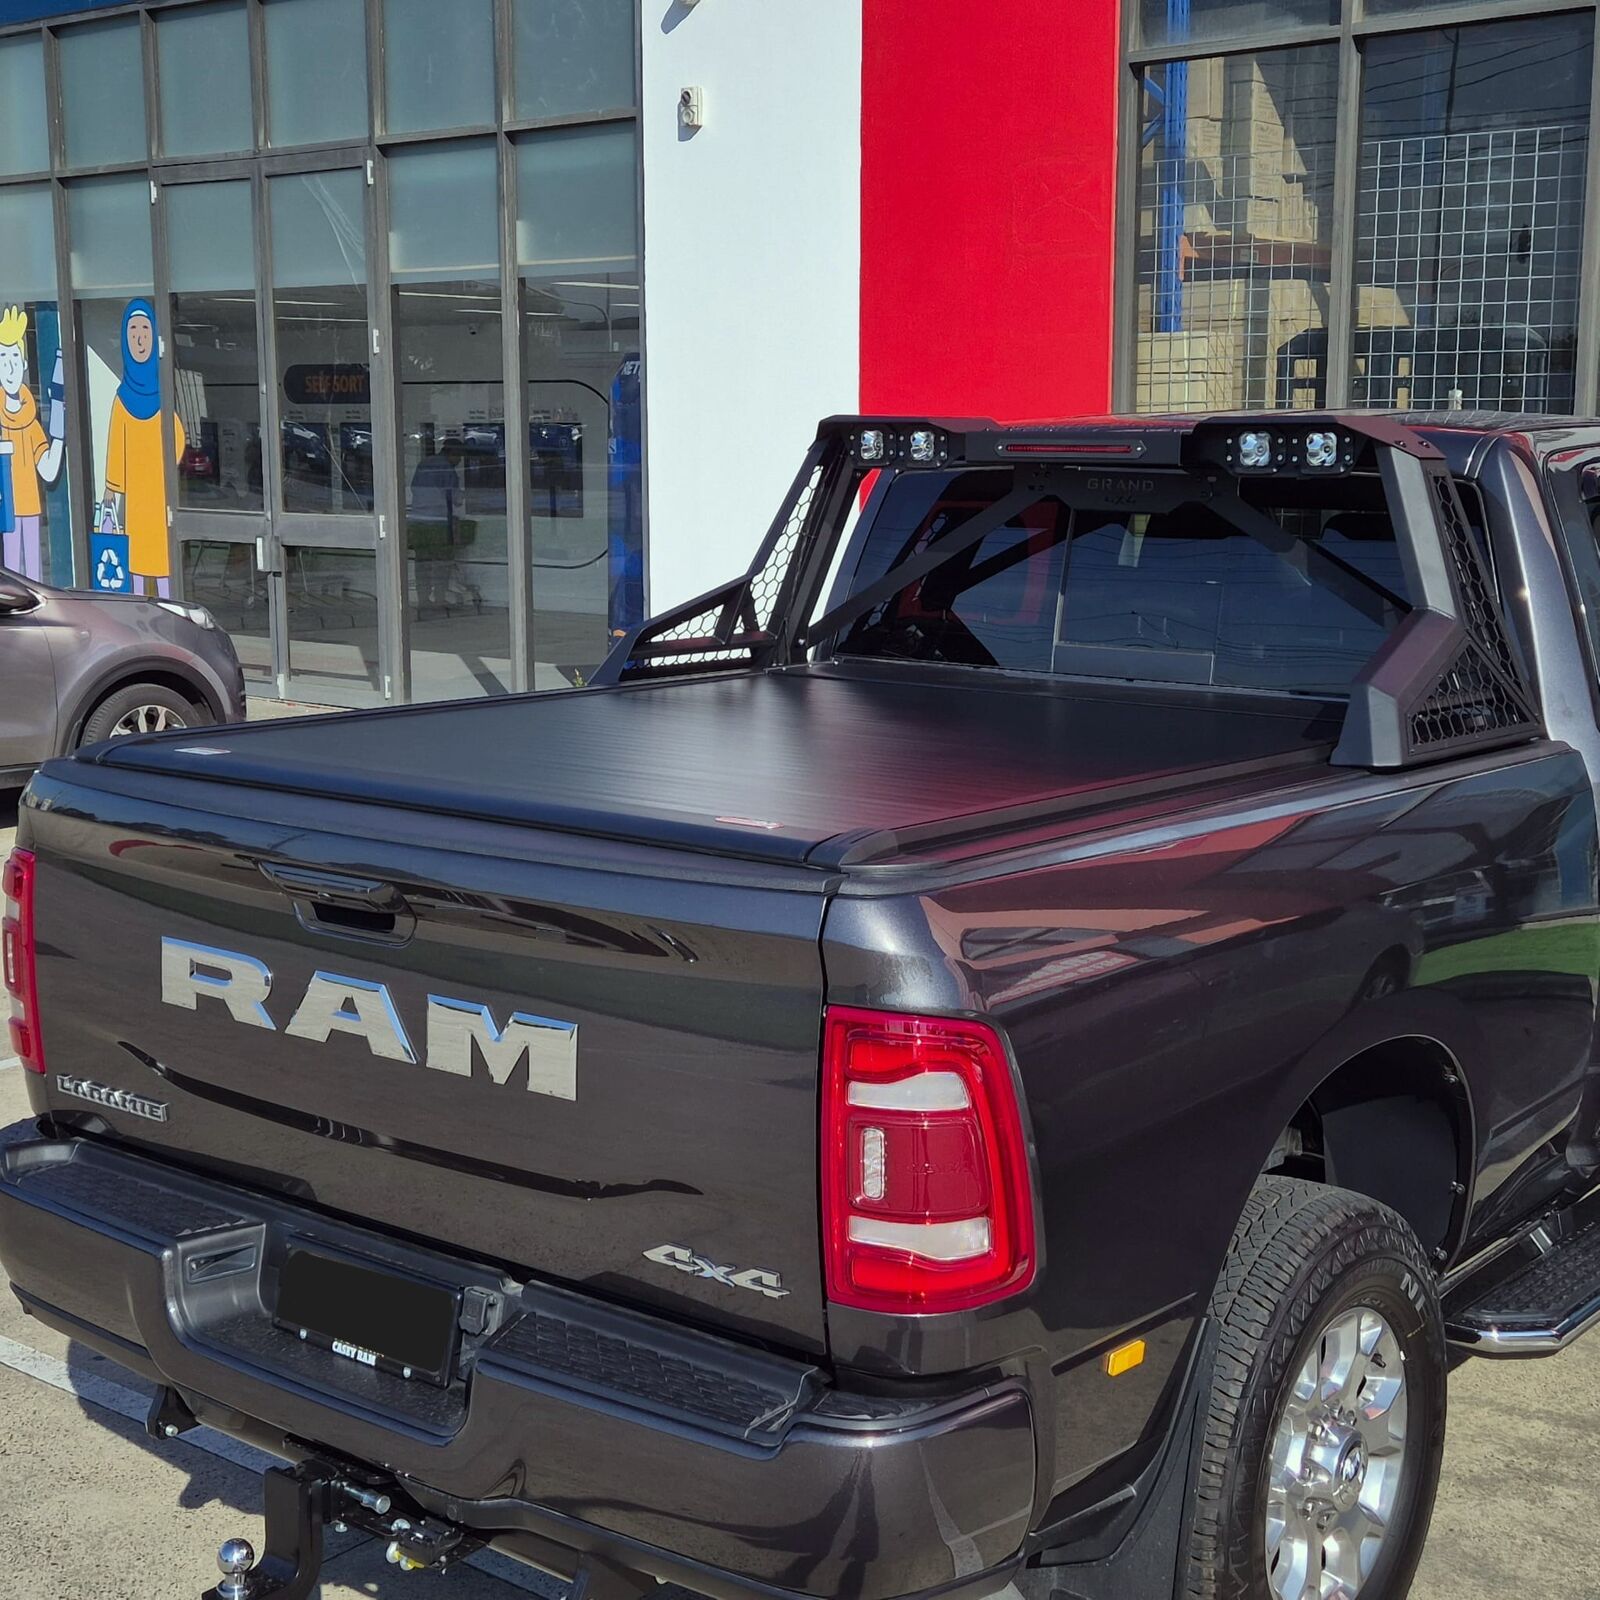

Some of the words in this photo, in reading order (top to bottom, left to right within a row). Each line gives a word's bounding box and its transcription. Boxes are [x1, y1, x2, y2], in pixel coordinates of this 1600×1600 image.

[304, 374, 332, 394] SELF
[333, 374, 364, 393] SORT
[1087, 477, 1155, 491] GRAND
[161, 935, 579, 1101] RAM
[57, 1073, 168, 1122] LARAMIE
